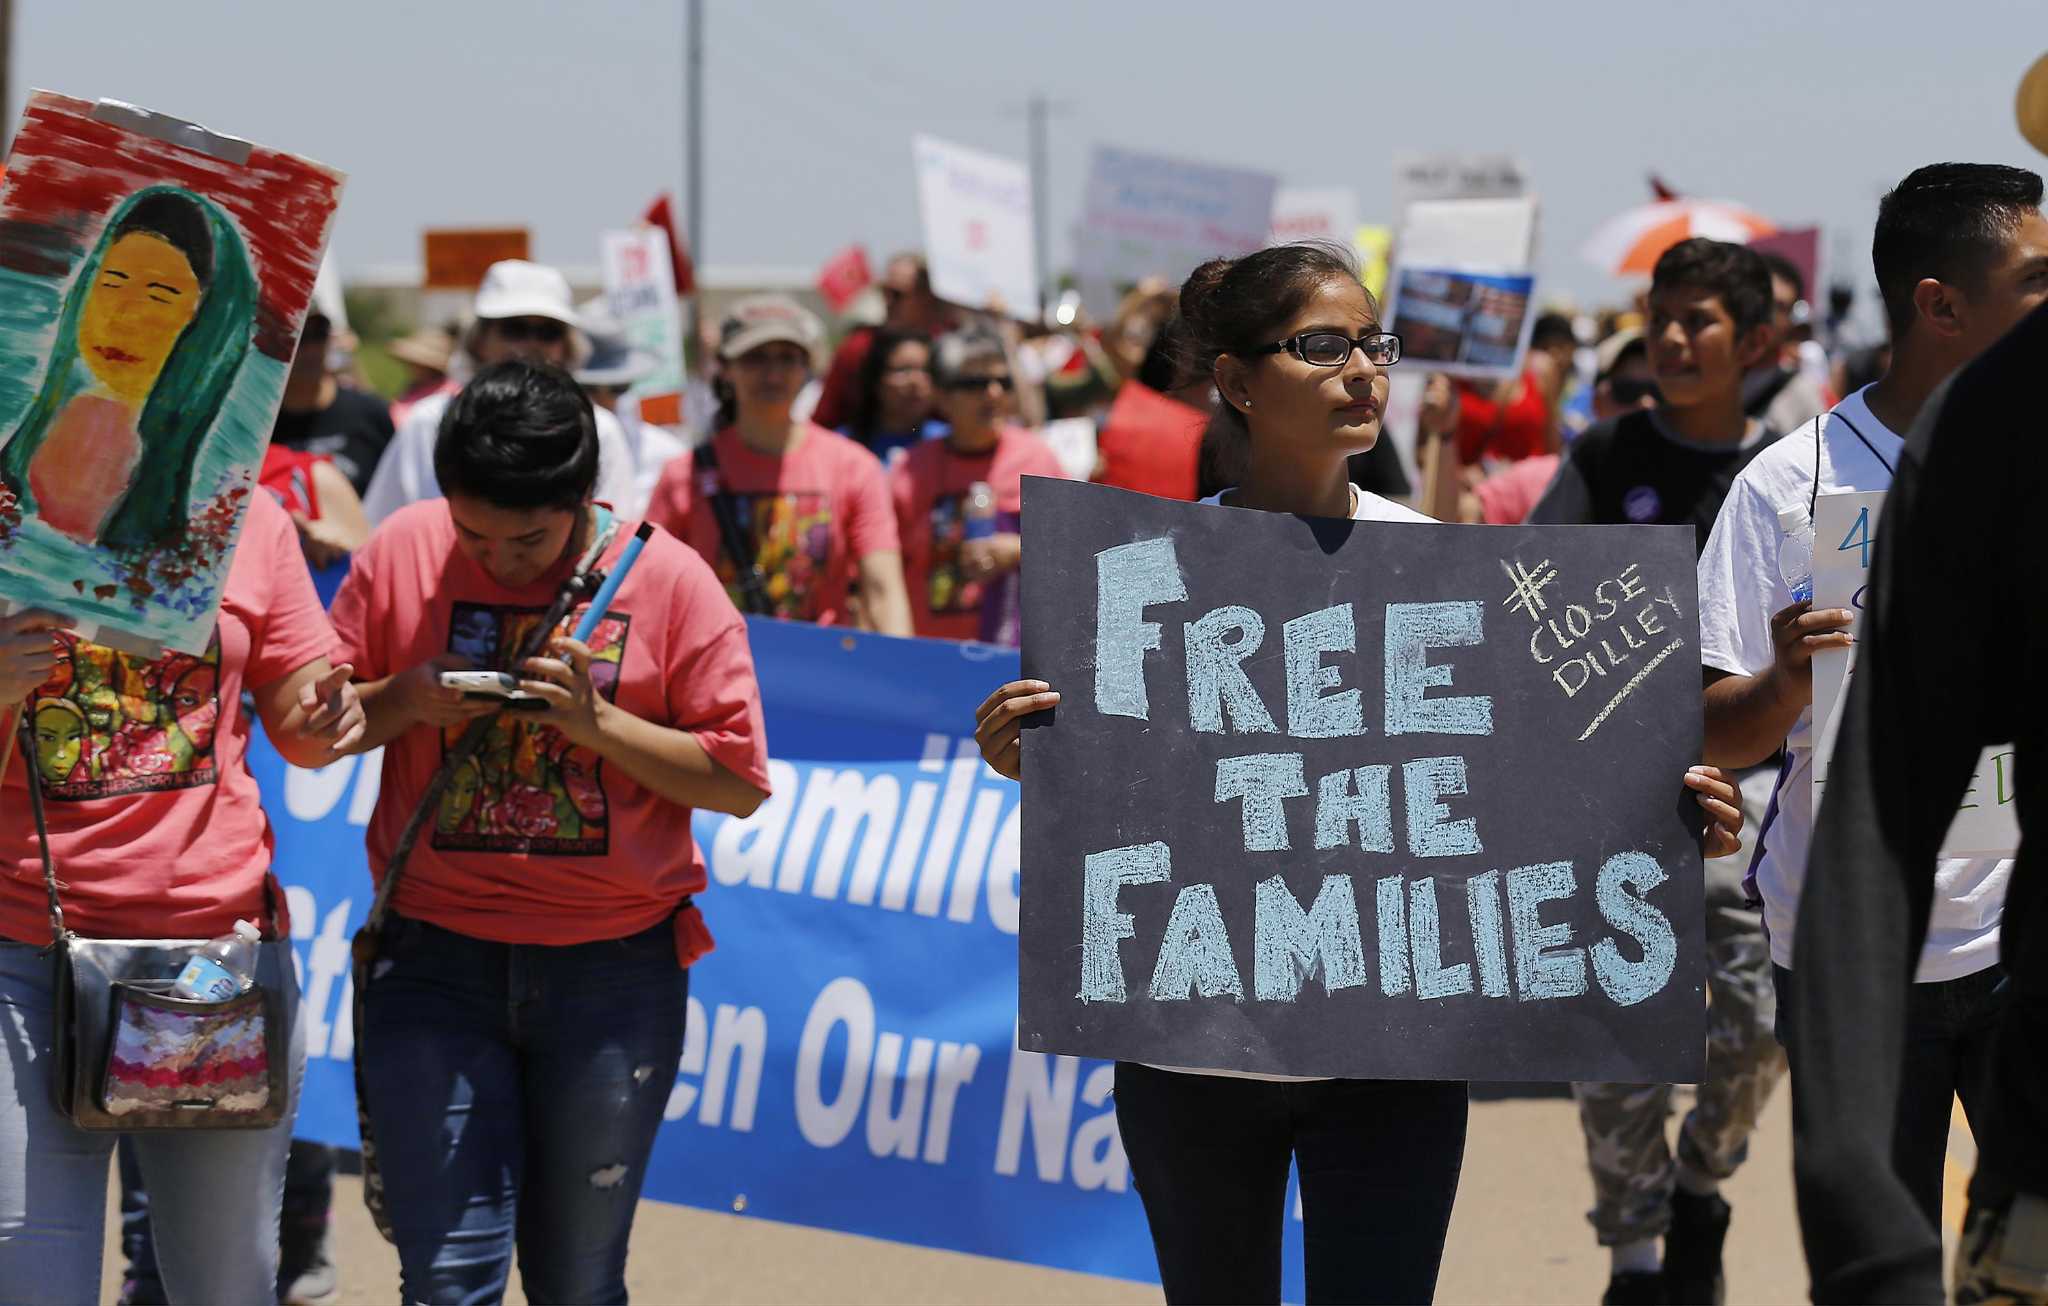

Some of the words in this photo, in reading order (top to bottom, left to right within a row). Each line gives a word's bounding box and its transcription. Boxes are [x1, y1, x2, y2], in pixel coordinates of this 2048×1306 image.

[1094, 536, 1494, 738] FREE
[1530, 563, 1647, 664] CLOSE
[1552, 586, 1684, 698] DILLEY
[711, 734, 1021, 936] amili
[1214, 752, 1484, 858] THE
[1075, 840, 1678, 1007] FAMILIES
[794, 976, 981, 1164] Our
